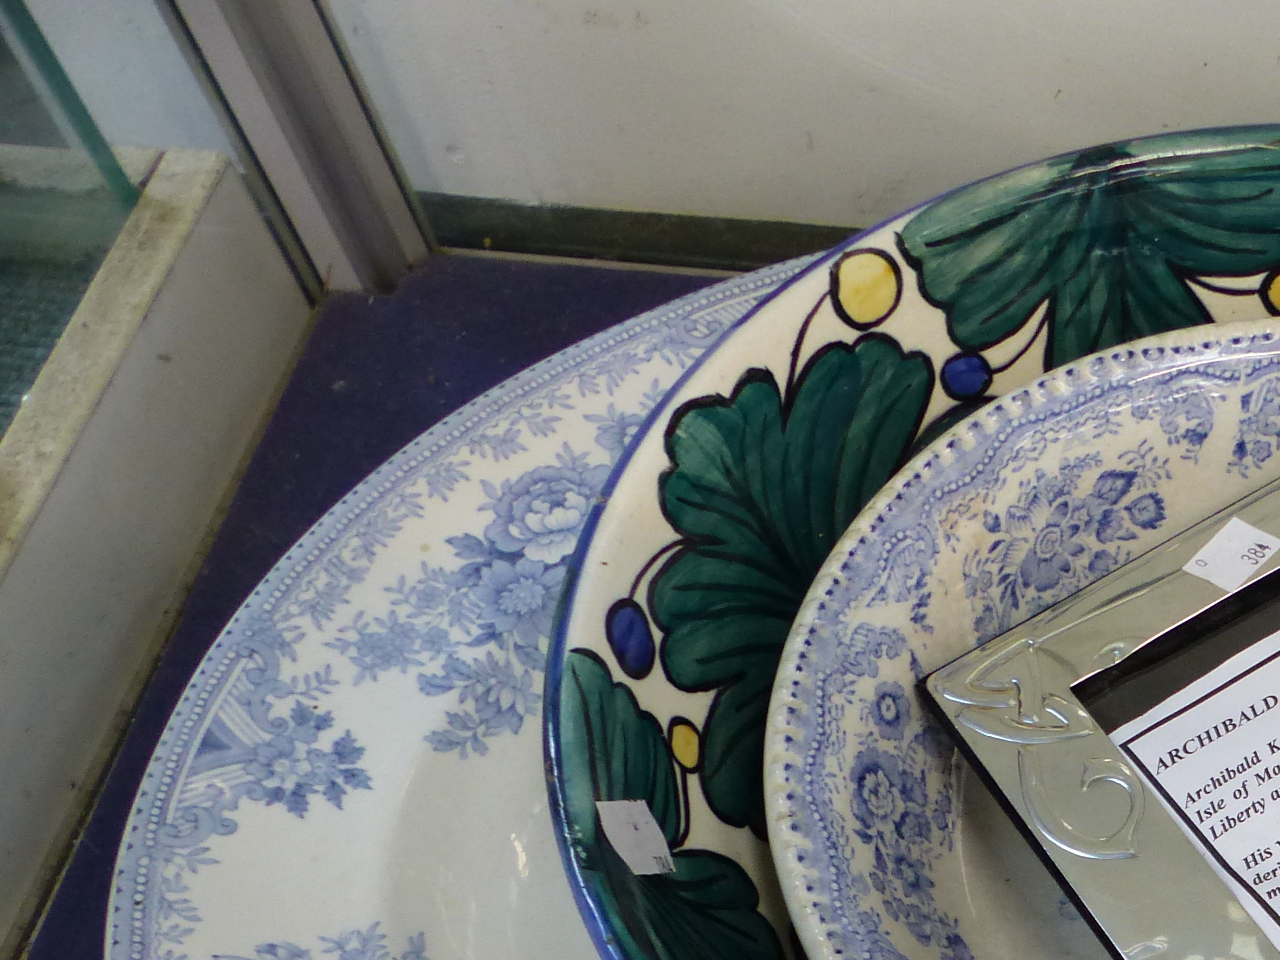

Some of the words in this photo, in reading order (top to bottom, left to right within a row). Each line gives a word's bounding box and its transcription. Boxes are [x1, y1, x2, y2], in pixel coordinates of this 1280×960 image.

[1240, 542, 1272, 566] 384
[1154, 695, 1279, 774] ARCHIBALD
[1184, 750, 1262, 807] Archibald
[1195, 798, 1227, 824] Isle
[1232, 779, 1249, 800] of
[1209, 797, 1266, 841] Liberty
[1242, 847, 1273, 871] His
